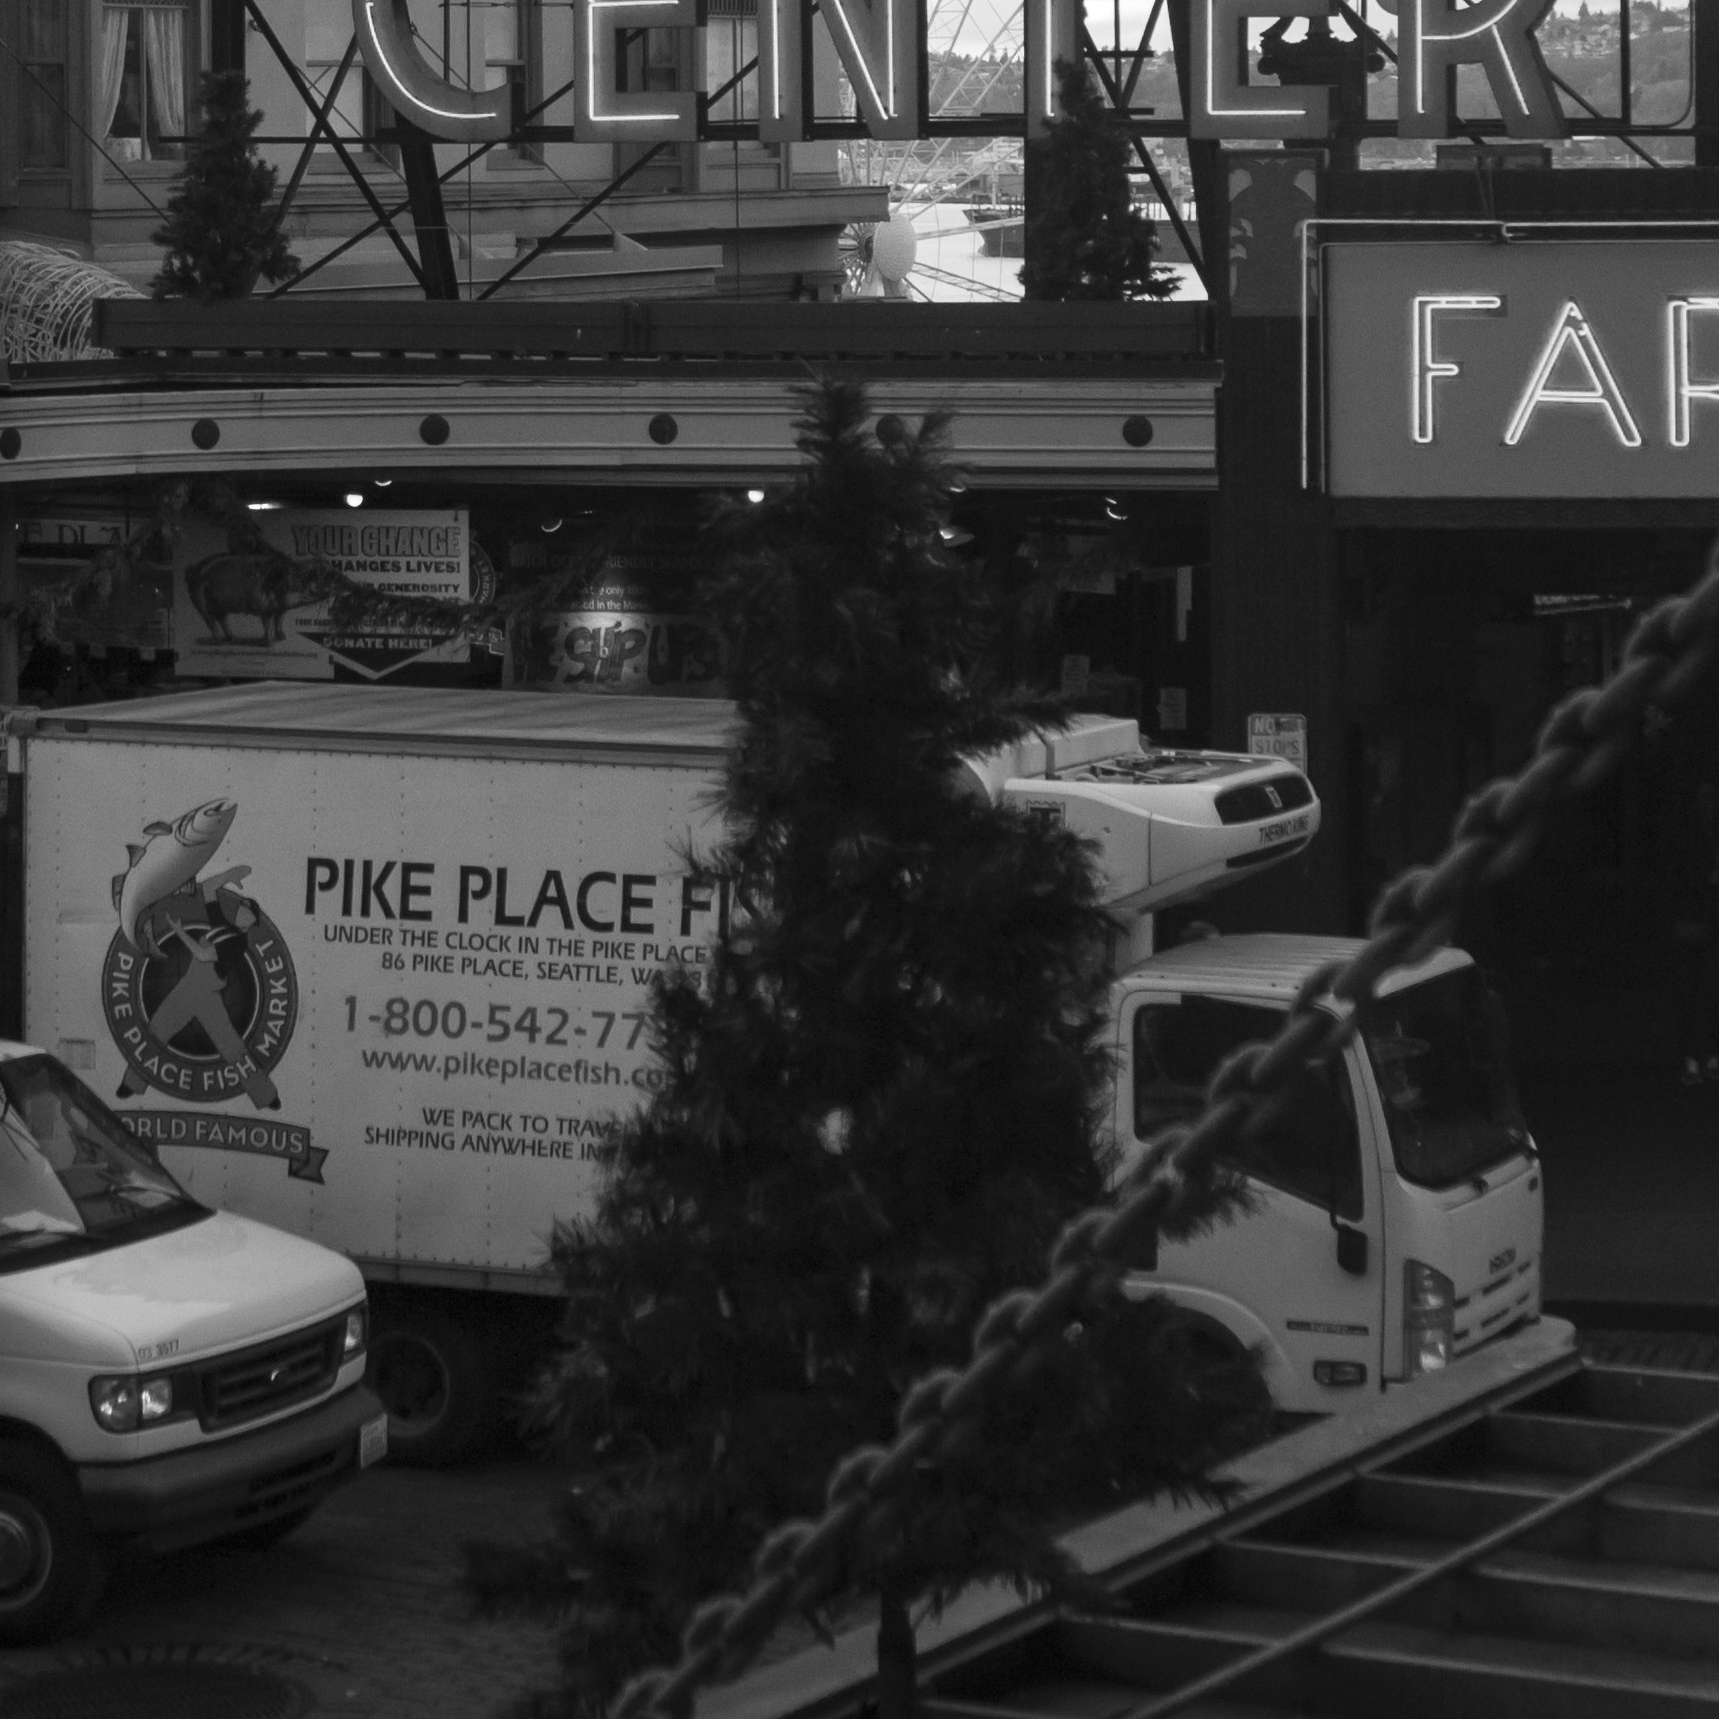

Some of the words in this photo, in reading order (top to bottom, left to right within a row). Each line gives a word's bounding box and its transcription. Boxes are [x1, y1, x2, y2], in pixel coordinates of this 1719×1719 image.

[291, 525, 359, 557] YOUR
[362, 525, 461, 558] CHANGE
[331, 560, 402, 573] HANGES
[406, 561, 461, 573] LIVES!
[379, 583, 460, 593] GENEROSITY
[323, 637, 384, 650] DONATE
[388, 638, 433, 650] HERE!
[1254, 717, 1276, 734] NO
[1259, 820, 1292, 844] THERMO
[305, 857, 435, 922] PIKE
[457, 865, 657, 934] PLACE
[324, 925, 393, 946] UNDER
[400, 929, 438, 949] THE
[445, 932, 511, 954] CLOCK
[519, 936, 539, 955] IN
[546, 937, 586, 958] THE
[592, 940, 635, 961] PIKE
[643, 944, 708, 965] PLACE
[382, 952, 406, 971] 86
[412, 954, 455, 974] PIKE
[461, 957, 529, 981] PLACE,
[537, 961, 624, 987] SEATTLE,
[112, 951, 134, 1020] PIKE
[123, 1026, 194, 1090] PLACE
[203, 1055, 257, 1091] FISH
[255, 939, 288, 1057] MARKET
[345, 995, 648, 1050] 1-800-542-77
[362, 1049, 677, 1086] www.pikeplacefish.co
[121, 1116, 187, 1139] ORLD
[195, 1120, 304, 1154] FAMOUS
[422, 1107, 456, 1127] WE
[461, 1109, 513, 1132] PACK
[519, 1114, 550, 1134] TO
[556, 1117, 613, 1139] TRAV
[364, 1126, 456, 1151] SHIPPING
[461, 1132, 574, 1159] ANYWHERE
